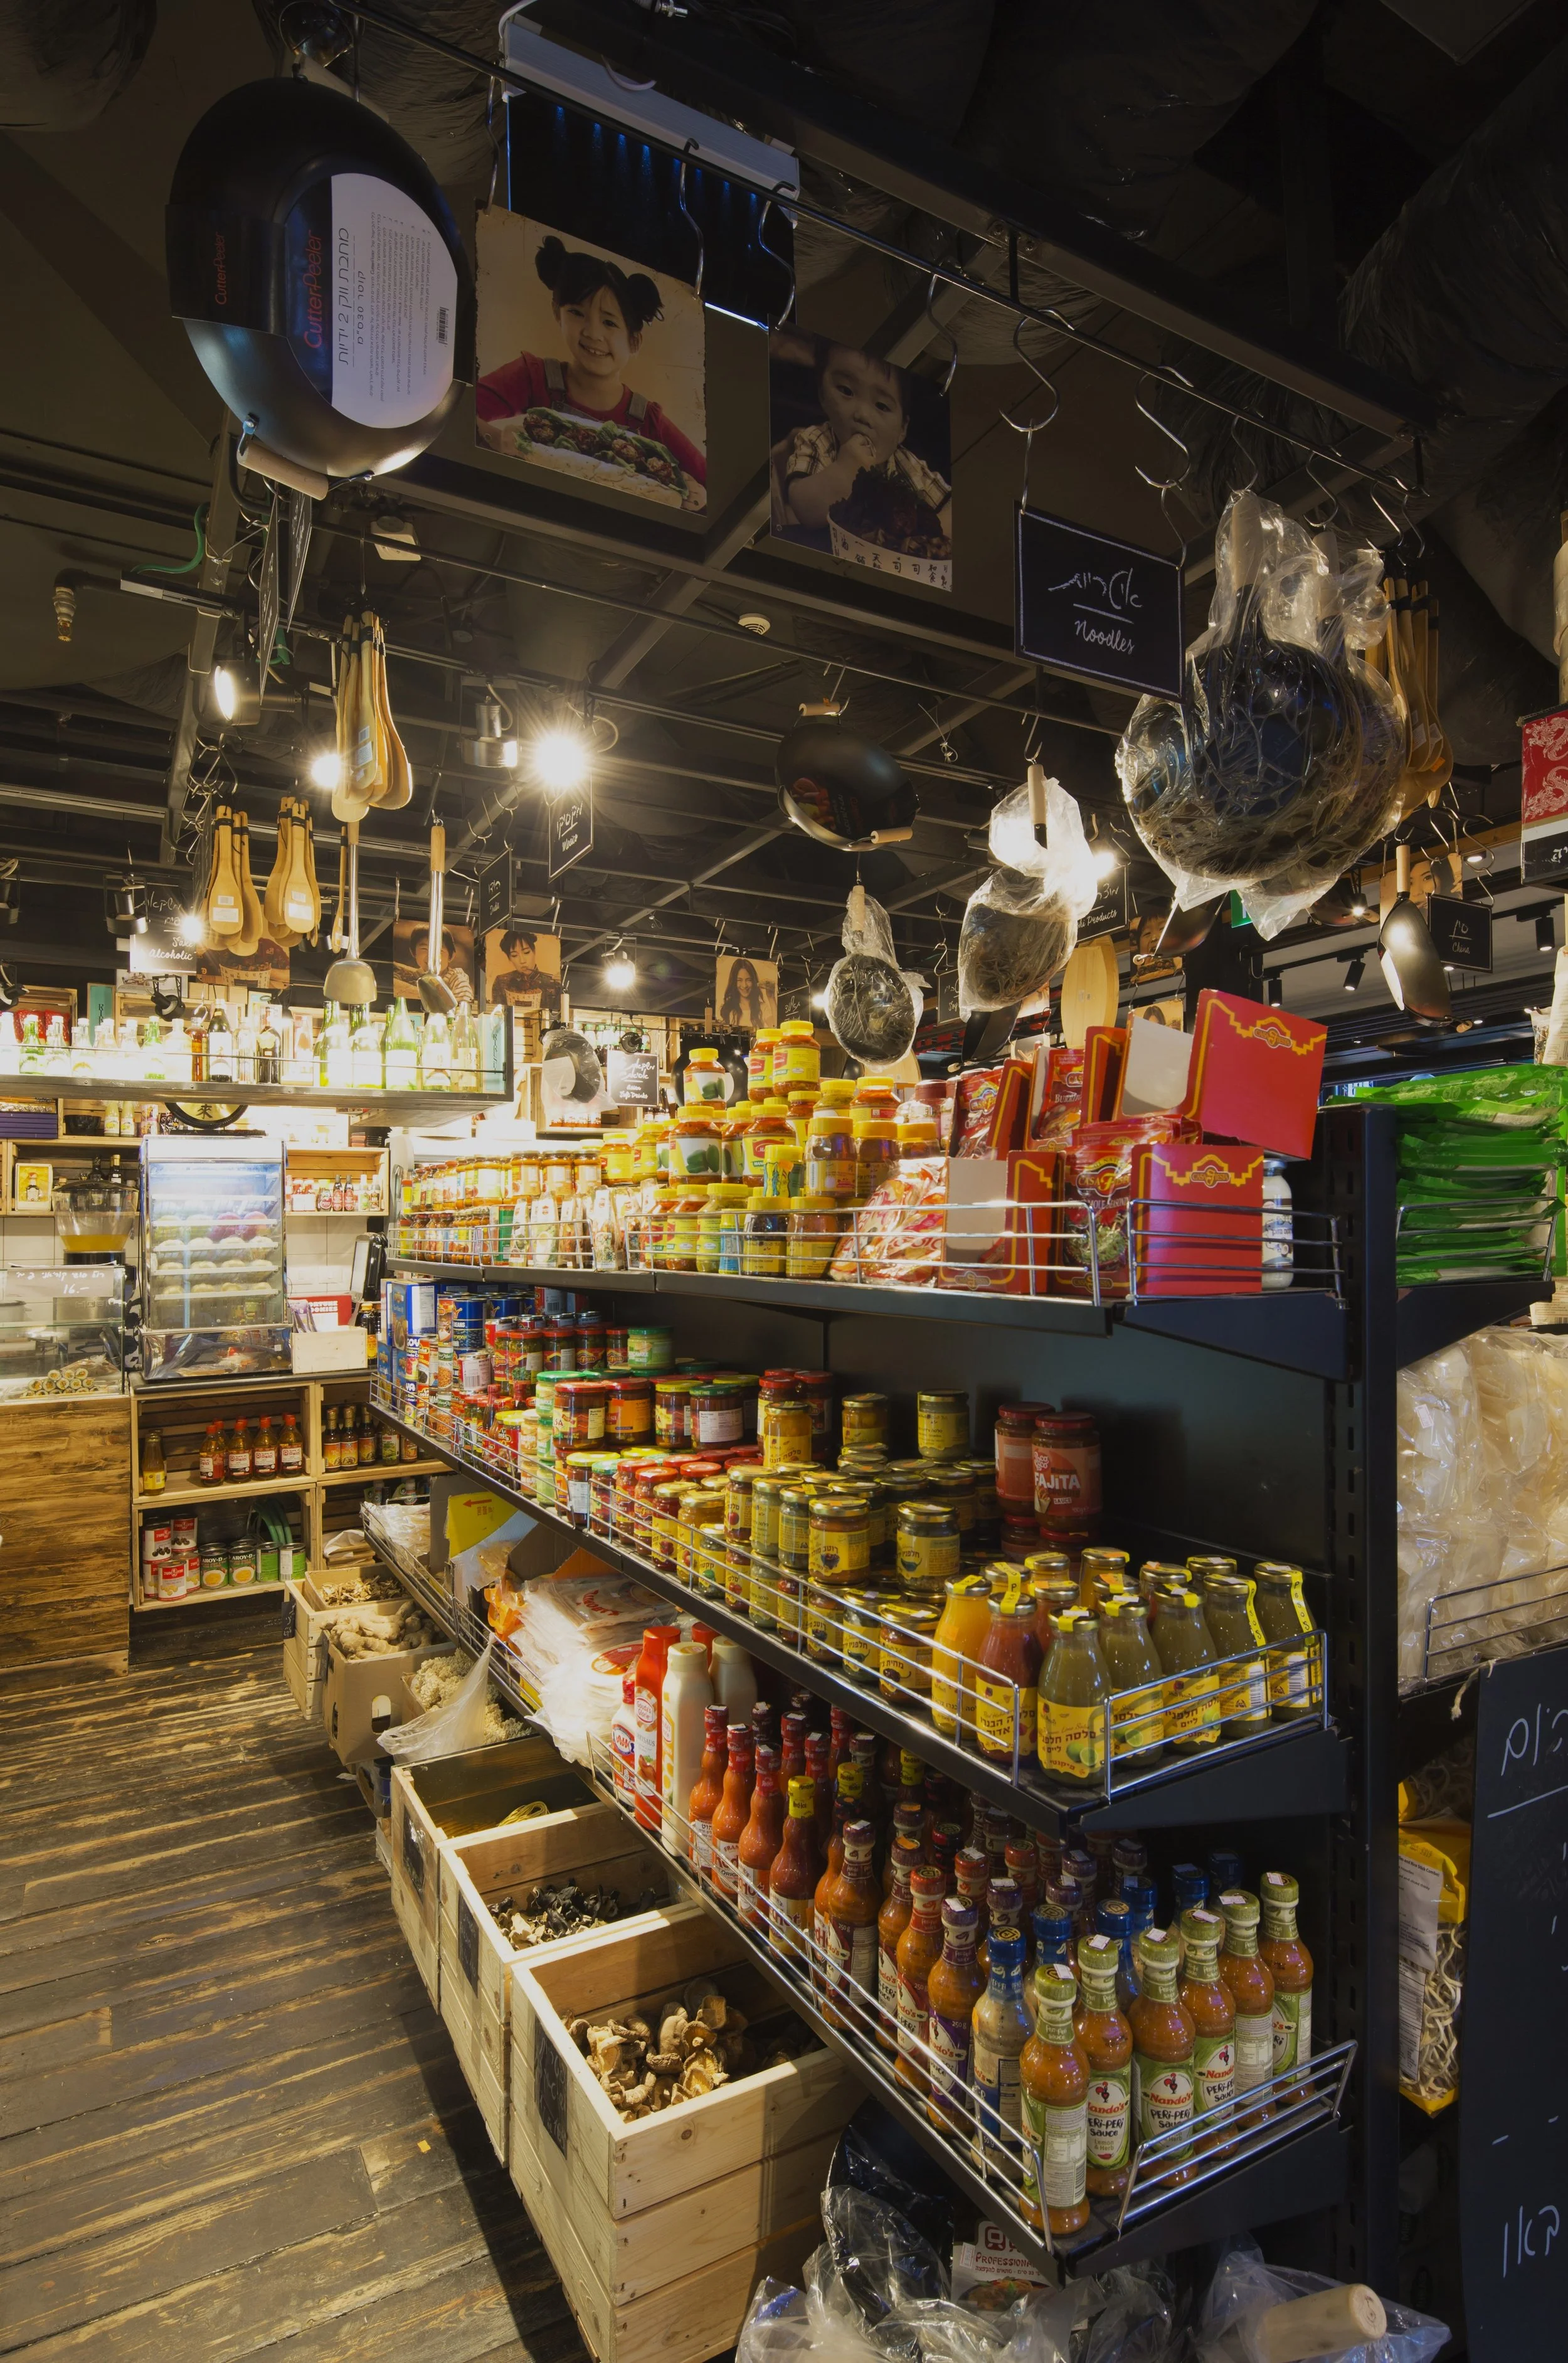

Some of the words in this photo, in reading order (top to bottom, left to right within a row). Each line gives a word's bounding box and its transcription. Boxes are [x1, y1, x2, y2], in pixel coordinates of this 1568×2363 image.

[304, 230, 322, 349] CutterPeeler
[1074, 620, 1135, 655] Noodles
[561, 834, 578, 852] Mexico
[1087, 908, 1118, 927] Products
[1150, 2092, 1192, 2105] Nando's
[975, 2251, 1035, 2268] PROFESSIONA
